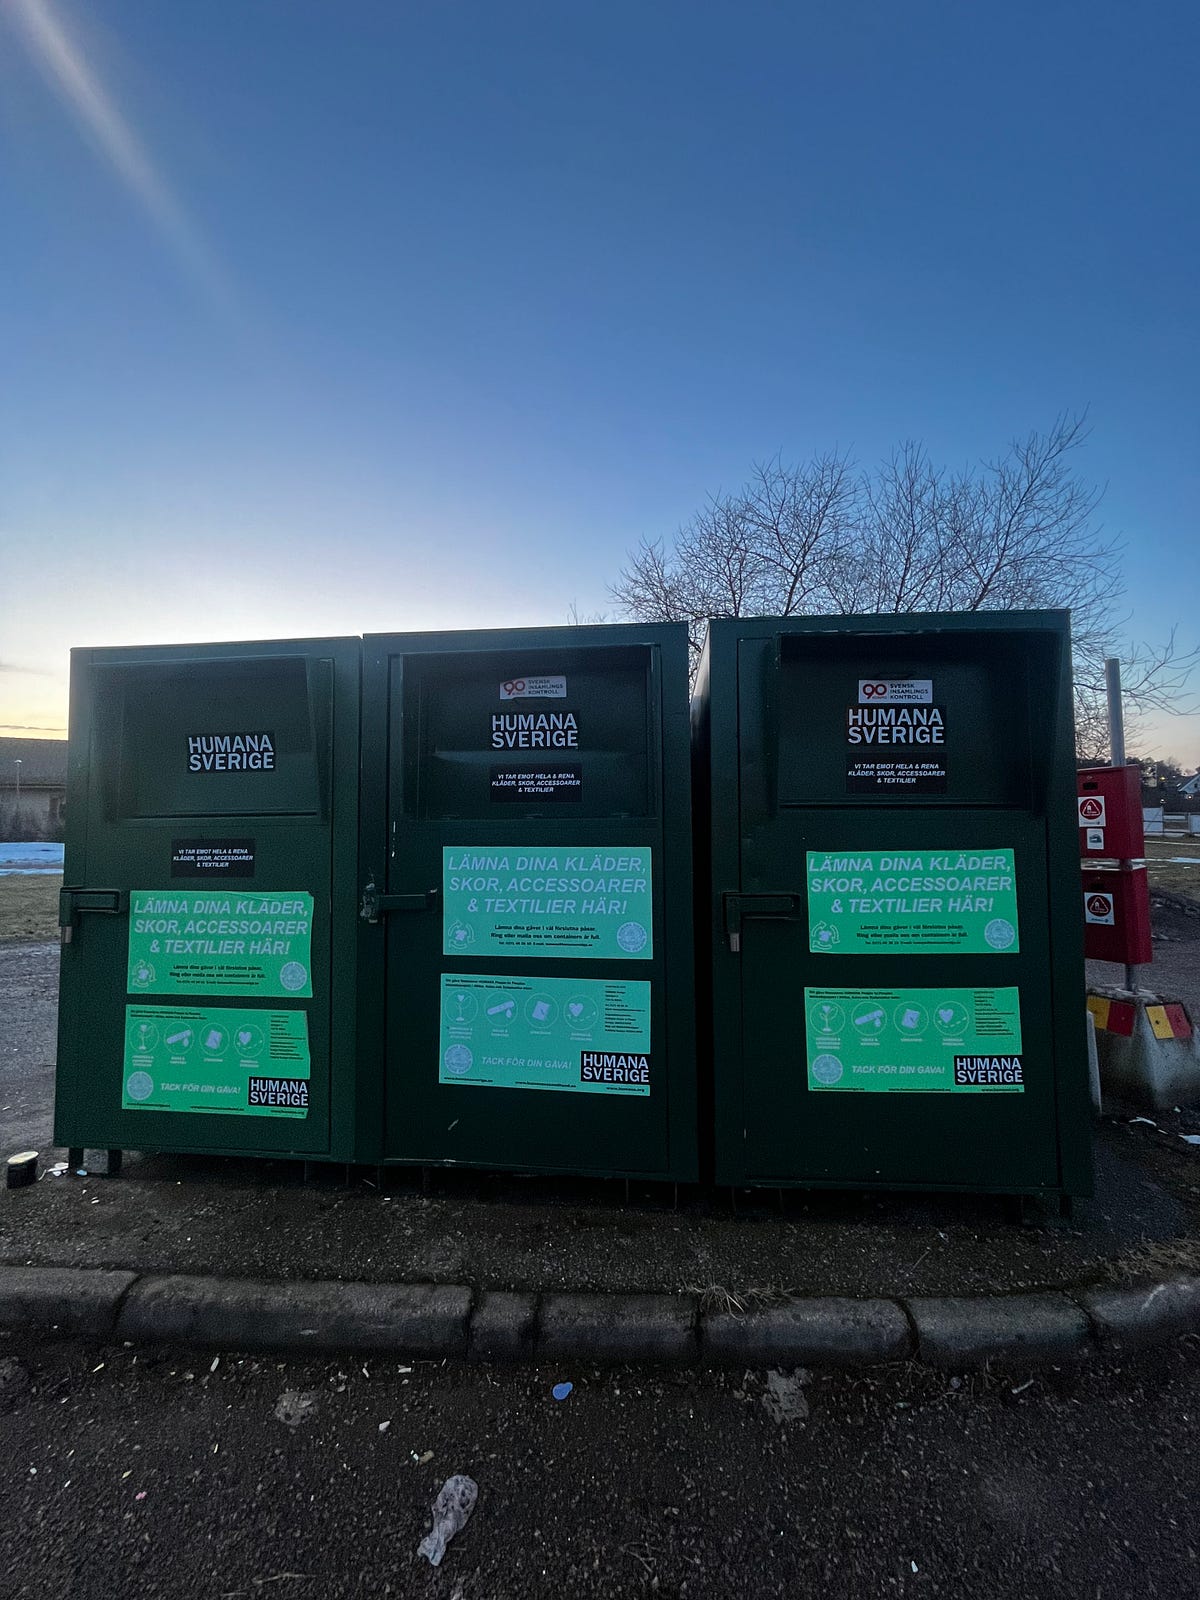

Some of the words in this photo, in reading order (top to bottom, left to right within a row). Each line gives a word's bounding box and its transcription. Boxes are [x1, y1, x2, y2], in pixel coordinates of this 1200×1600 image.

[504, 681, 525, 695] 90
[863, 684, 887, 699] 90
[492, 713, 577, 731] HUMANA
[848, 708, 943, 726] HUMANA
[492, 730, 578, 748] SVERIGE
[848, 726, 944, 744] SVERIGE
[189, 735, 273, 753] HUMANA
[189, 752, 274, 770] SVERIGE
[449, 854, 509, 870] LÄMNA
[516, 857, 558, 871] DINA
[565, 854, 646, 873] KLÄDER,
[809, 855, 873, 872] LÄMNA
[879, 858, 923, 871] DINA
[930, 854, 1011, 872] KLÄDER,
[449, 877, 502, 893] SKOR,
[507, 878, 646, 893] ACCESSOARER
[811, 878, 867, 894] SKOR,
[871, 877, 1011, 892] ACCESSOARER
[135, 897, 188, 914] LÄMNA
[194, 900, 230, 914] DINA
[467, 898, 478, 912] &
[484, 899, 575, 914] TEXTILIER
[581, 897, 627, 914] HÄR!
[831, 899, 843, 913] &
[849, 898, 943, 913] TEXTILIER
[948, 895, 993, 912] HÄR!
[135, 920, 181, 935] SKOR,
[184, 921, 307, 935] ACCESSOARER
[150, 940, 160, 952] &
[165, 940, 244, 954] TEXTILIER
[249, 938, 290, 954] HÄR!
[482, 1057, 504, 1065] TACK
[527, 1058, 542, 1067] DIN
[584, 1054, 649, 1069] HUMANA
[957, 1057, 1021, 1070] HUMANA
[583, 1067, 650, 1083] SVERIGE
[852, 1066, 875, 1074] TACK
[899, 1066, 915, 1074] DIN
[957, 1070, 1023, 1083] SVERIGE
[161, 1083, 180, 1091] TACK
[251, 1079, 307, 1093] HUMANA
[251, 1092, 309, 1106] SVERIGE
